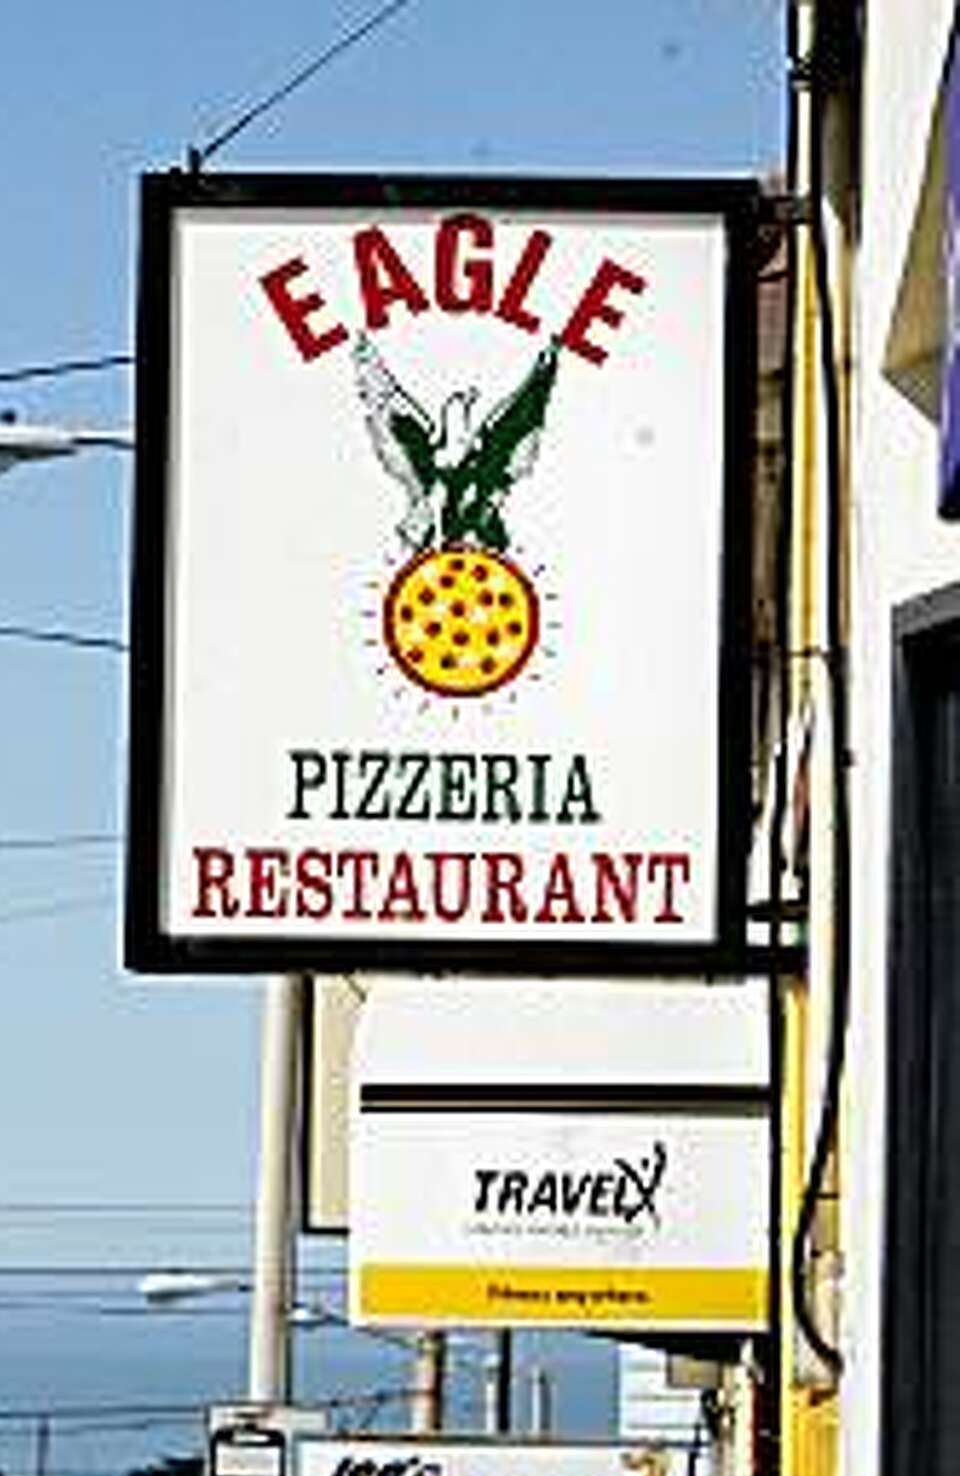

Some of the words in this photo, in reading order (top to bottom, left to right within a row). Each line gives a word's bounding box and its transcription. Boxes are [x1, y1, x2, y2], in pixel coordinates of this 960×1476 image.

[259, 212, 646, 368] EAGLE
[287, 750, 601, 825] PIZZERIA
[191, 846, 691, 925] RESTAURANT
